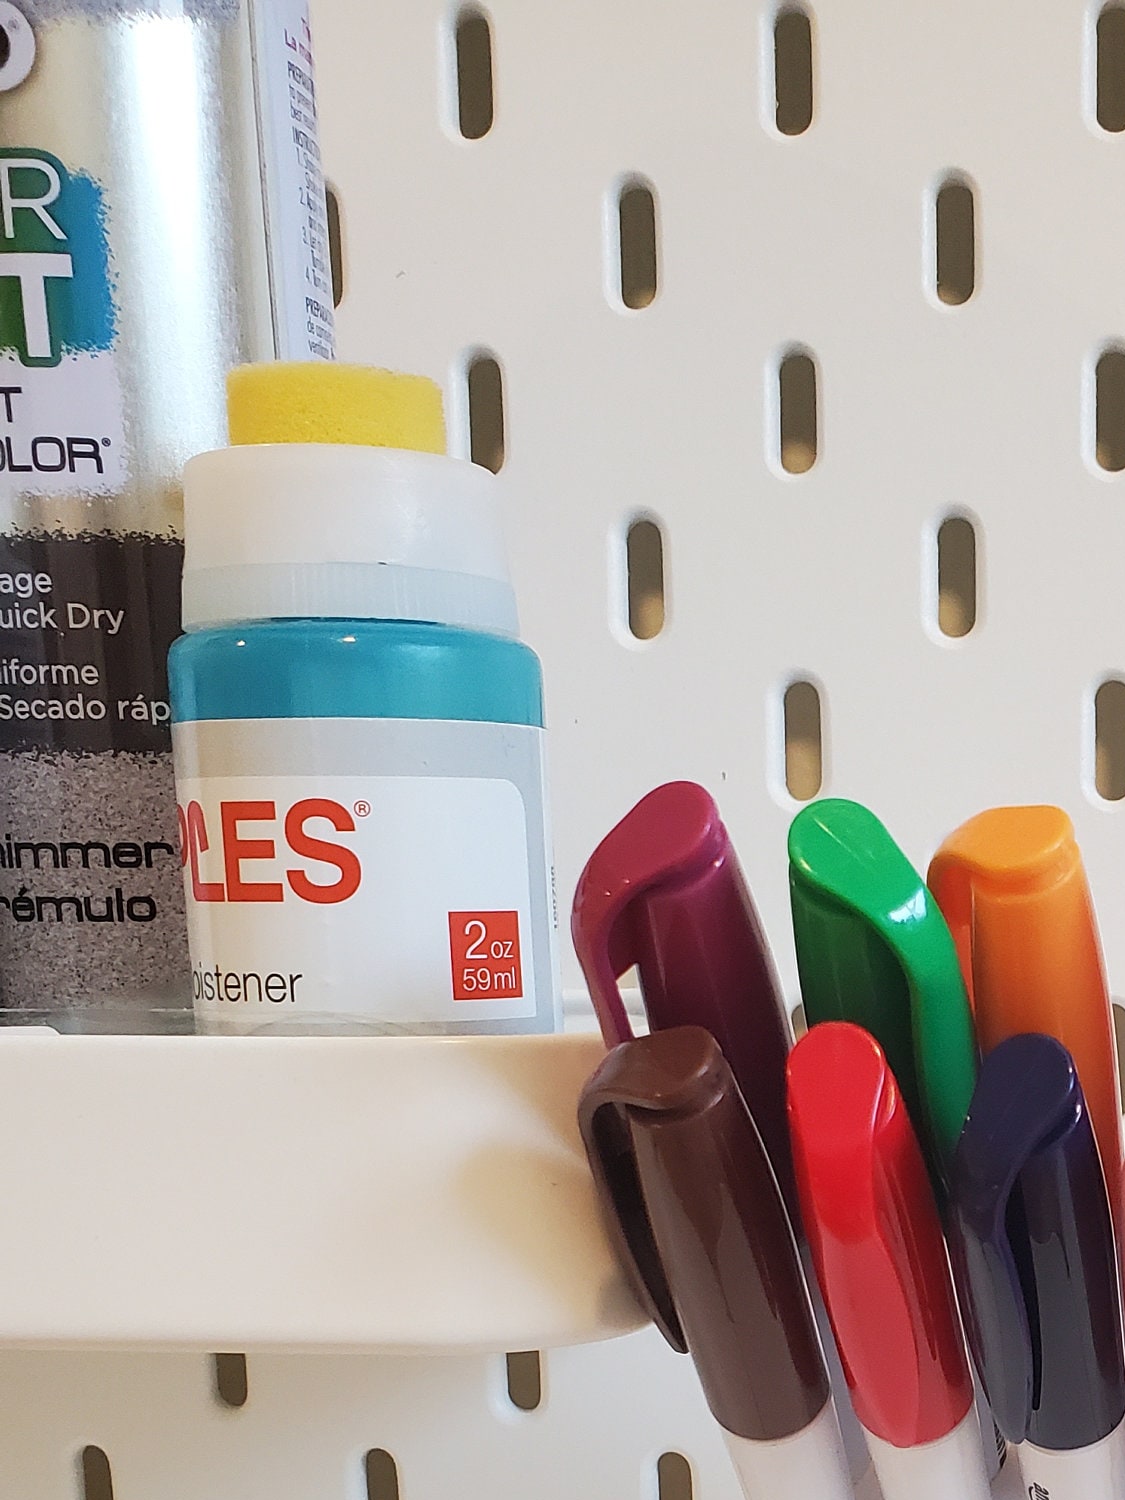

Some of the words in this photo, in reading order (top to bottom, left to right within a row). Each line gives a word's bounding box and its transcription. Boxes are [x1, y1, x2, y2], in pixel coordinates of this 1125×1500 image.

[0, 436, 104, 474] LOR
[0, 572, 52, 598] age
[0, 602, 58, 629] uick
[67, 602, 125, 635] Dry
[0, 693, 106, 720] Secado
